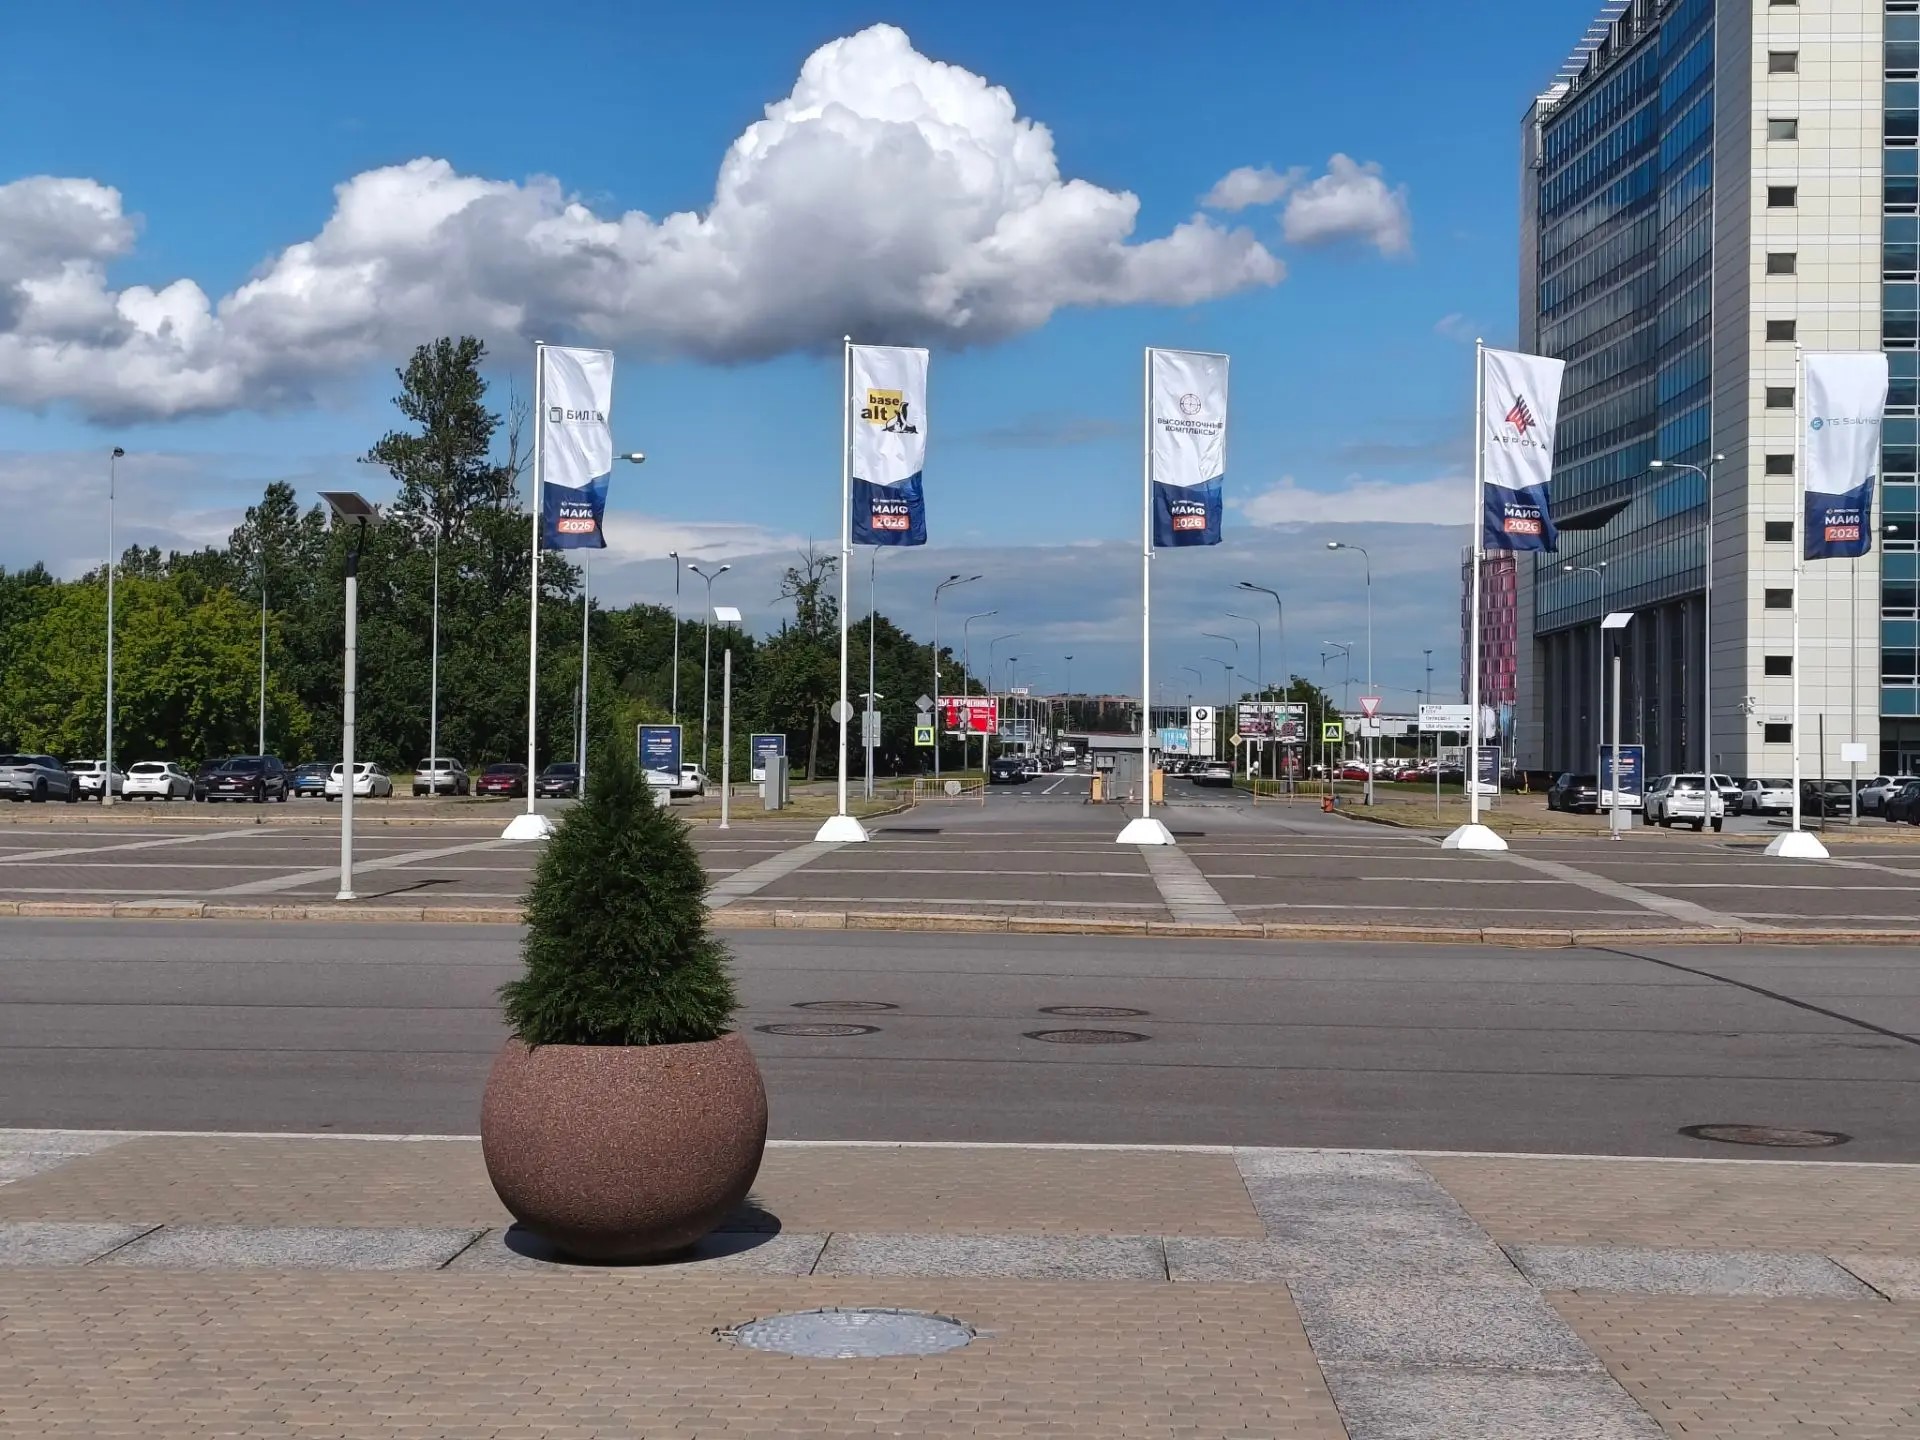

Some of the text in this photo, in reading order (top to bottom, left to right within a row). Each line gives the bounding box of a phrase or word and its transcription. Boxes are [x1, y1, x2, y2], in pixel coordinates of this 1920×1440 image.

[869, 394, 900, 406] base
[860, 405, 888, 421] alt
[1157, 417, 1223, 429] ВЫСОКОТОЧНЫЕ
[1826, 417, 1840, 426] TS
[1165, 425, 1216, 436] КОМПЛЕКСЫ
[872, 505, 909, 514] МАИФ
[1171, 505, 1206, 516] МАИФ
[1504, 507, 1541, 519] МАИФ
[562, 520, 592, 531] 2026
[876, 517, 906, 528] 2026
[1174, 518, 1203, 528] 2026
[1508, 519, 1540, 532] 2026
[1829, 528, 1860, 539] 2026
